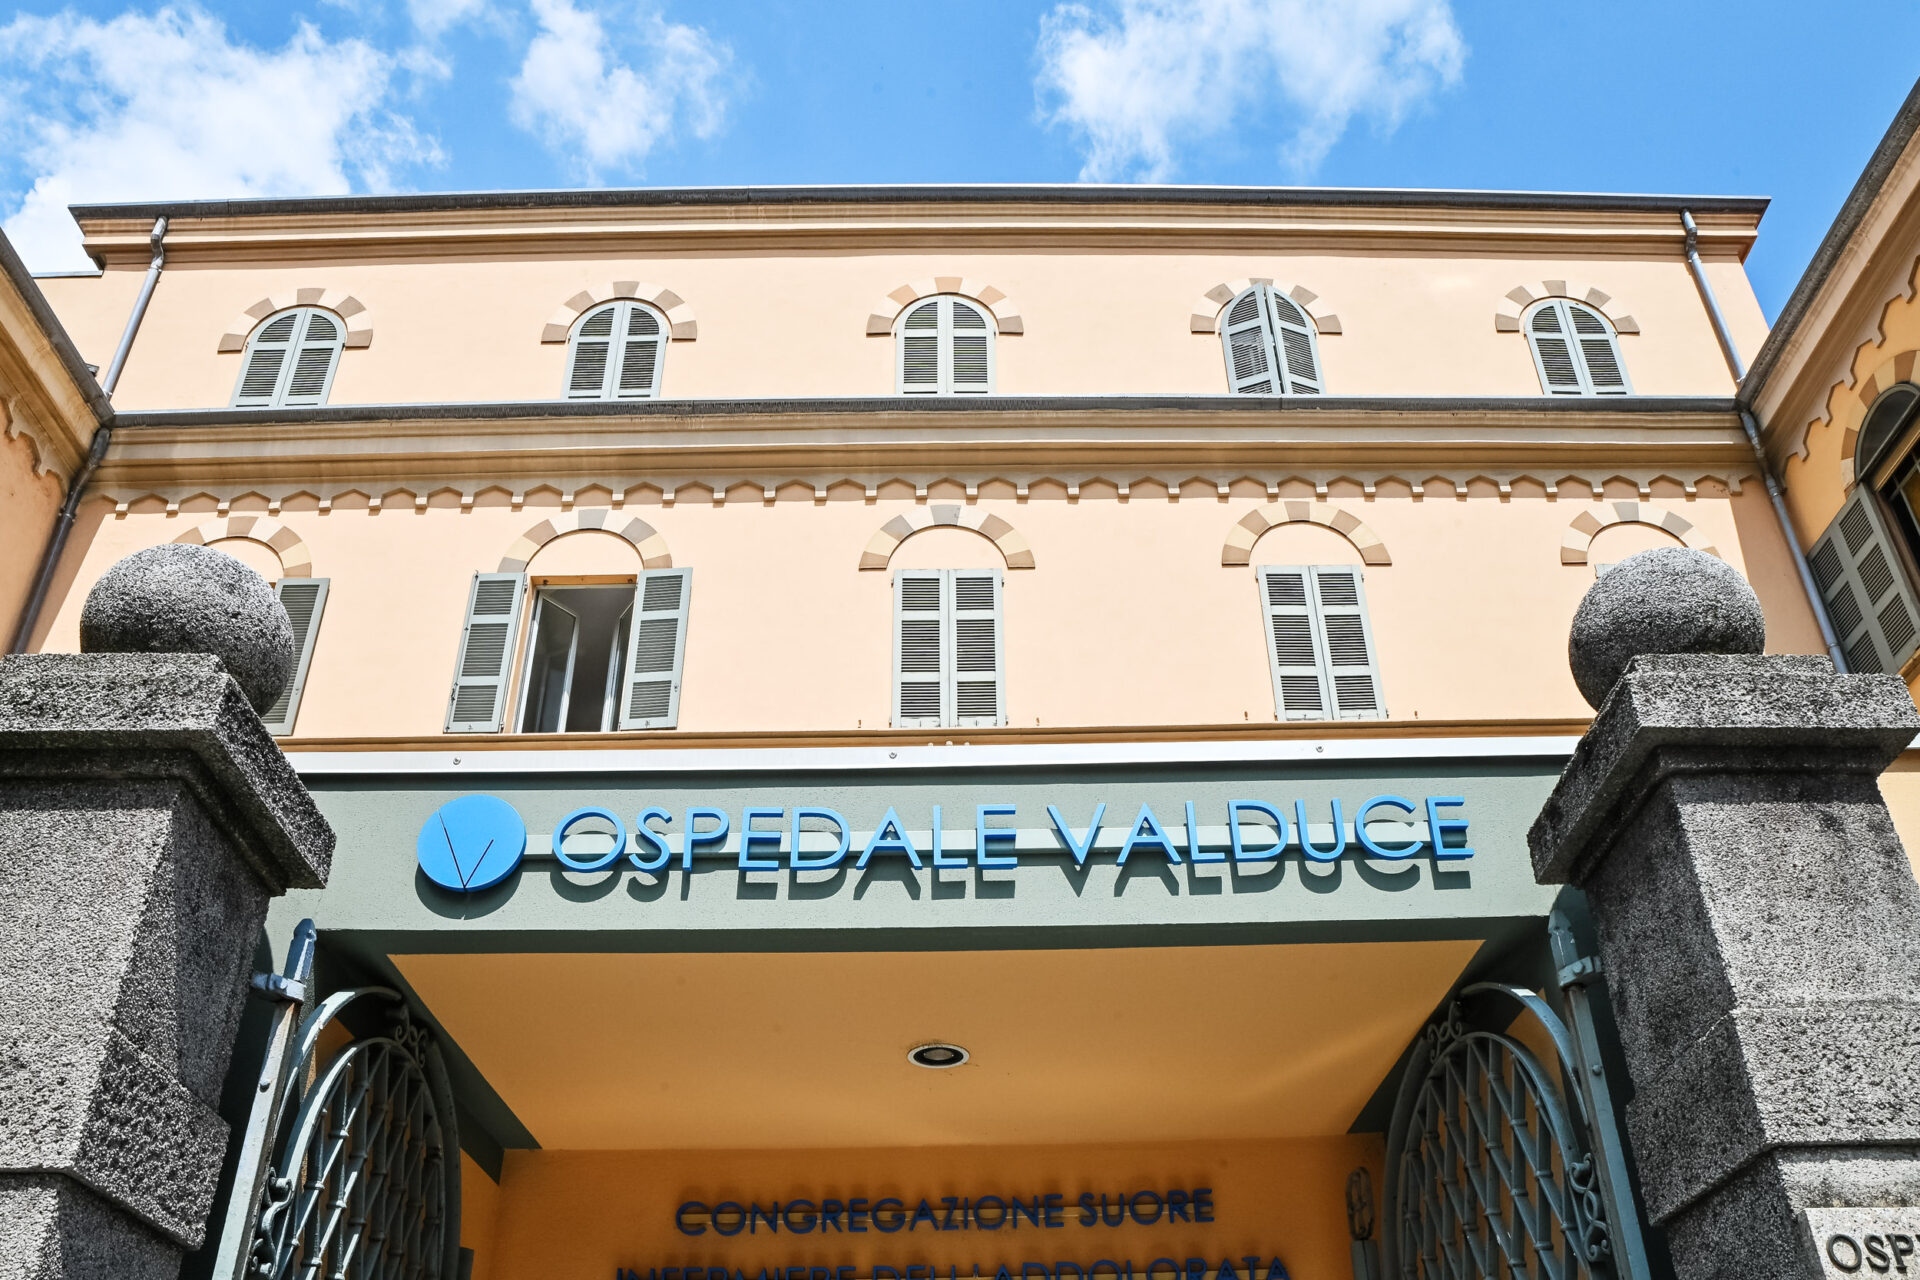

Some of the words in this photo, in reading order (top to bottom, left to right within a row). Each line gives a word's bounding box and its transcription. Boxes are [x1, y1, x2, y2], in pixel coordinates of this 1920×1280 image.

[552, 804, 1018, 873] OSPEDALE
[1046, 794, 1475, 867] VALDUCE
[675, 1194, 1065, 1237] CONGREGAZIONE
[1077, 1188, 1215, 1228] SUORE
[1826, 1233, 1920, 1274] OSP
